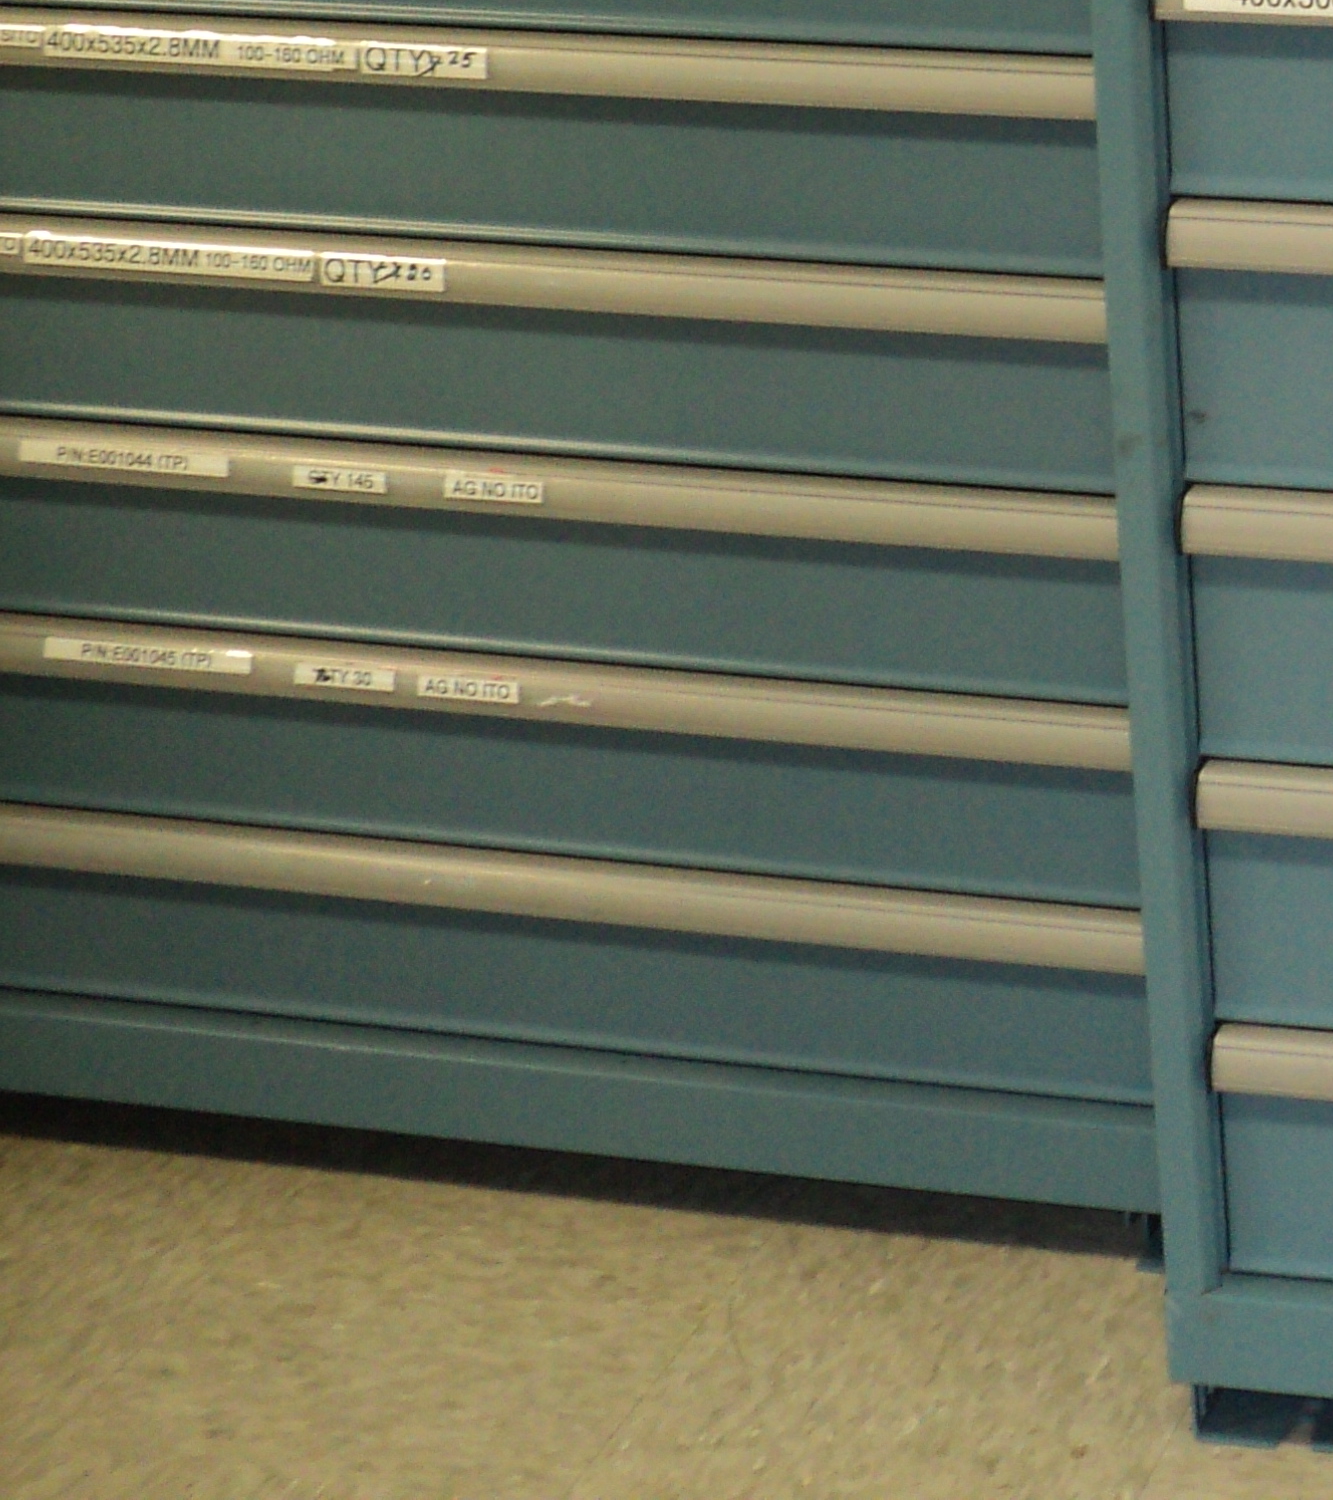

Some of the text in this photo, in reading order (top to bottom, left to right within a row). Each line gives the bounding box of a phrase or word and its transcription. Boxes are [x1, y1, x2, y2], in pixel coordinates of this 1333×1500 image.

[46, 30, 221, 60] 400x535x2.8MM
[306, 48, 346, 66] OHM
[28, 238, 200, 268] 400x535x2.8MM
[273, 256, 312, 274] OHM
[453, 479, 539, 501] AG NO ITO
[425, 678, 511, 700] AG NO ITO
